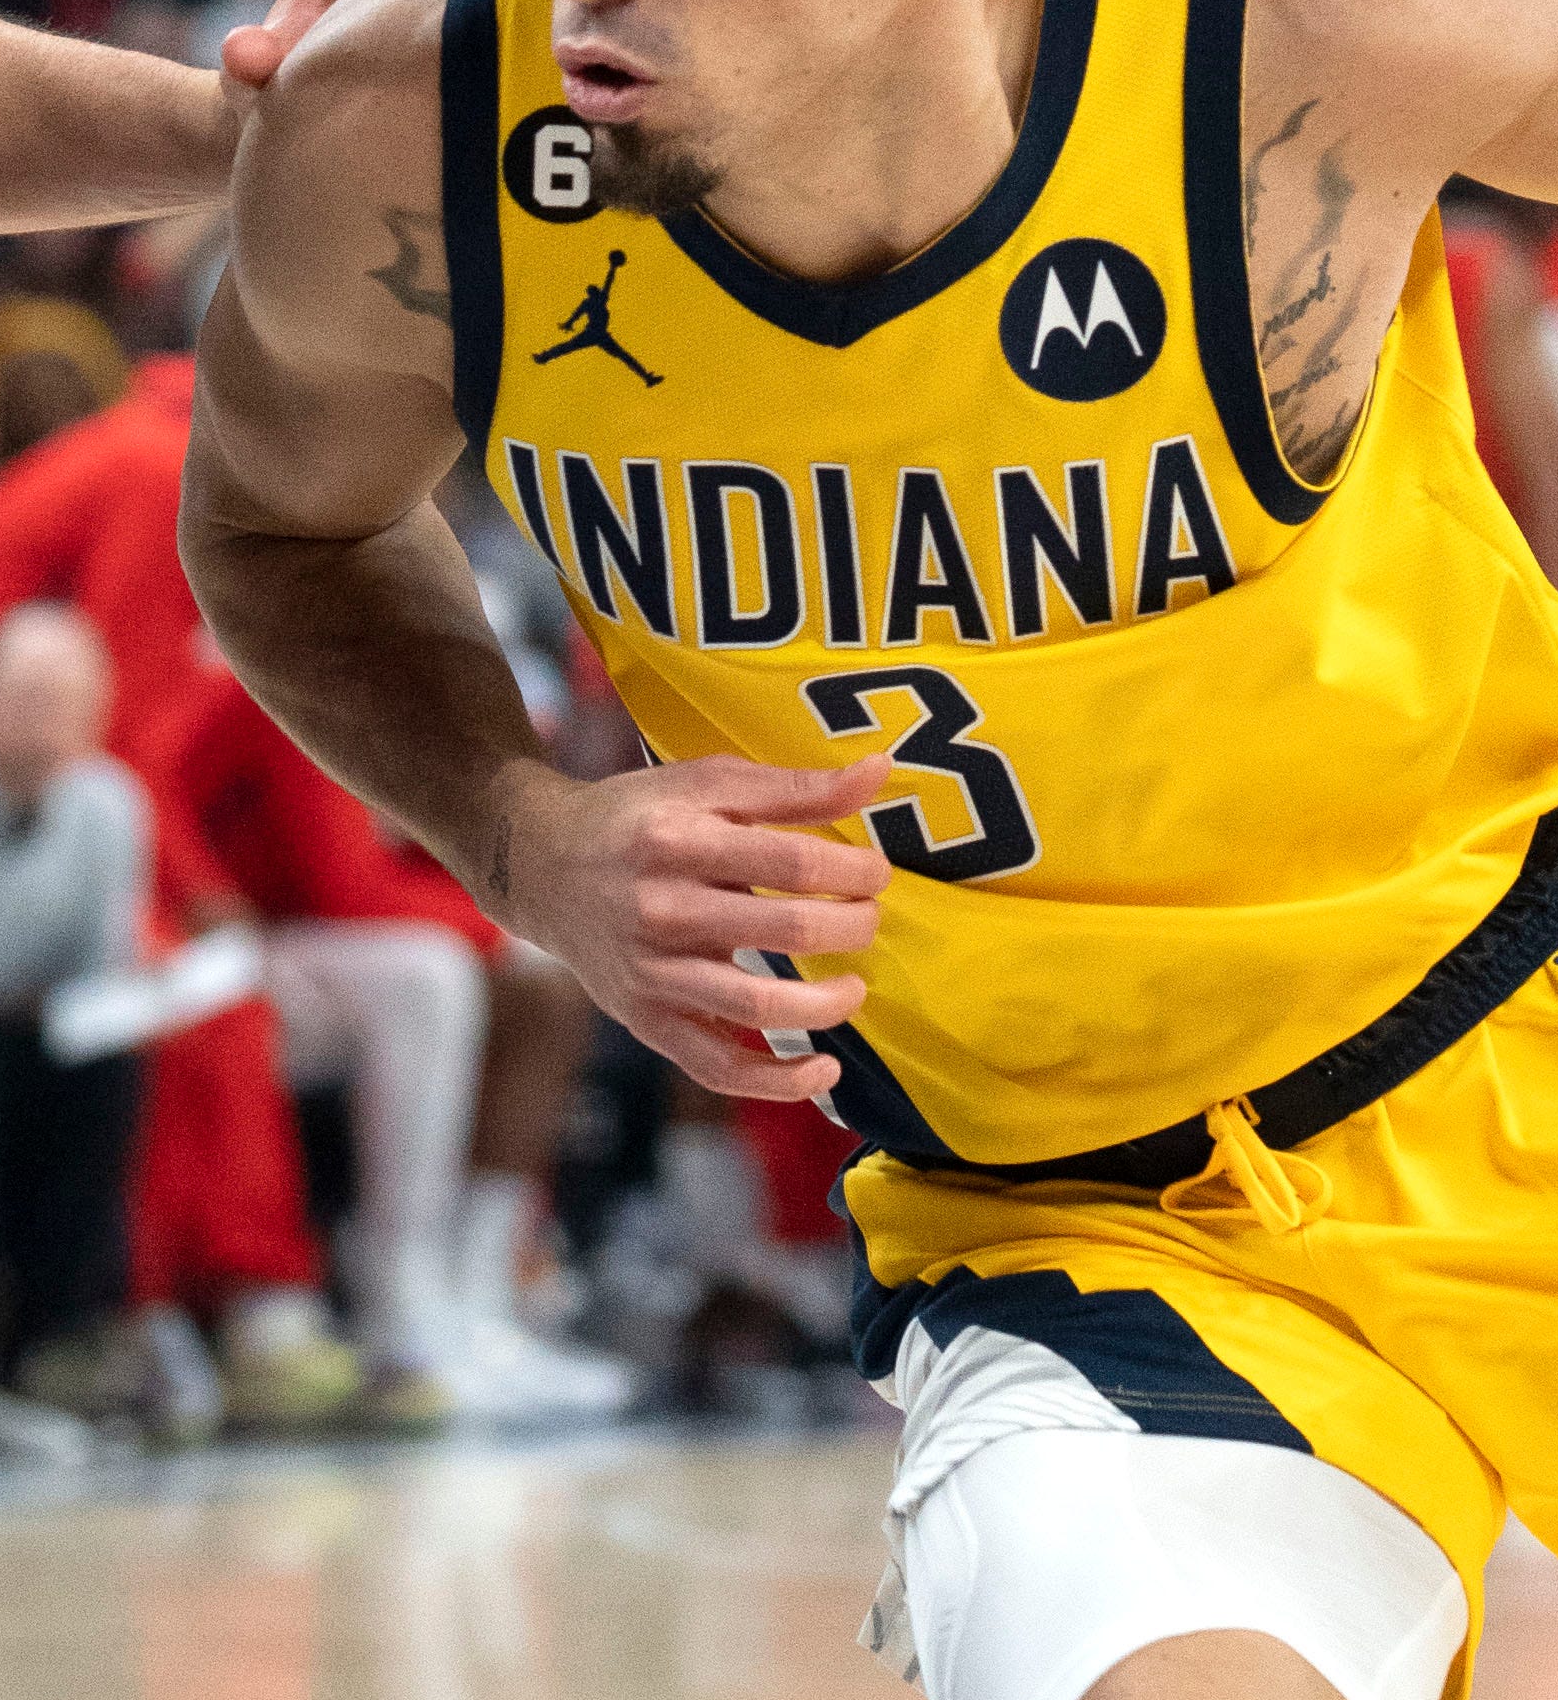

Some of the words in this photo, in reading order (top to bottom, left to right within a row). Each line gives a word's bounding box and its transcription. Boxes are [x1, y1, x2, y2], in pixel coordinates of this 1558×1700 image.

[531, 123, 592, 210] 6
[501, 434, 1241, 650] INDIANA
[798, 663, 1041, 883] 3
